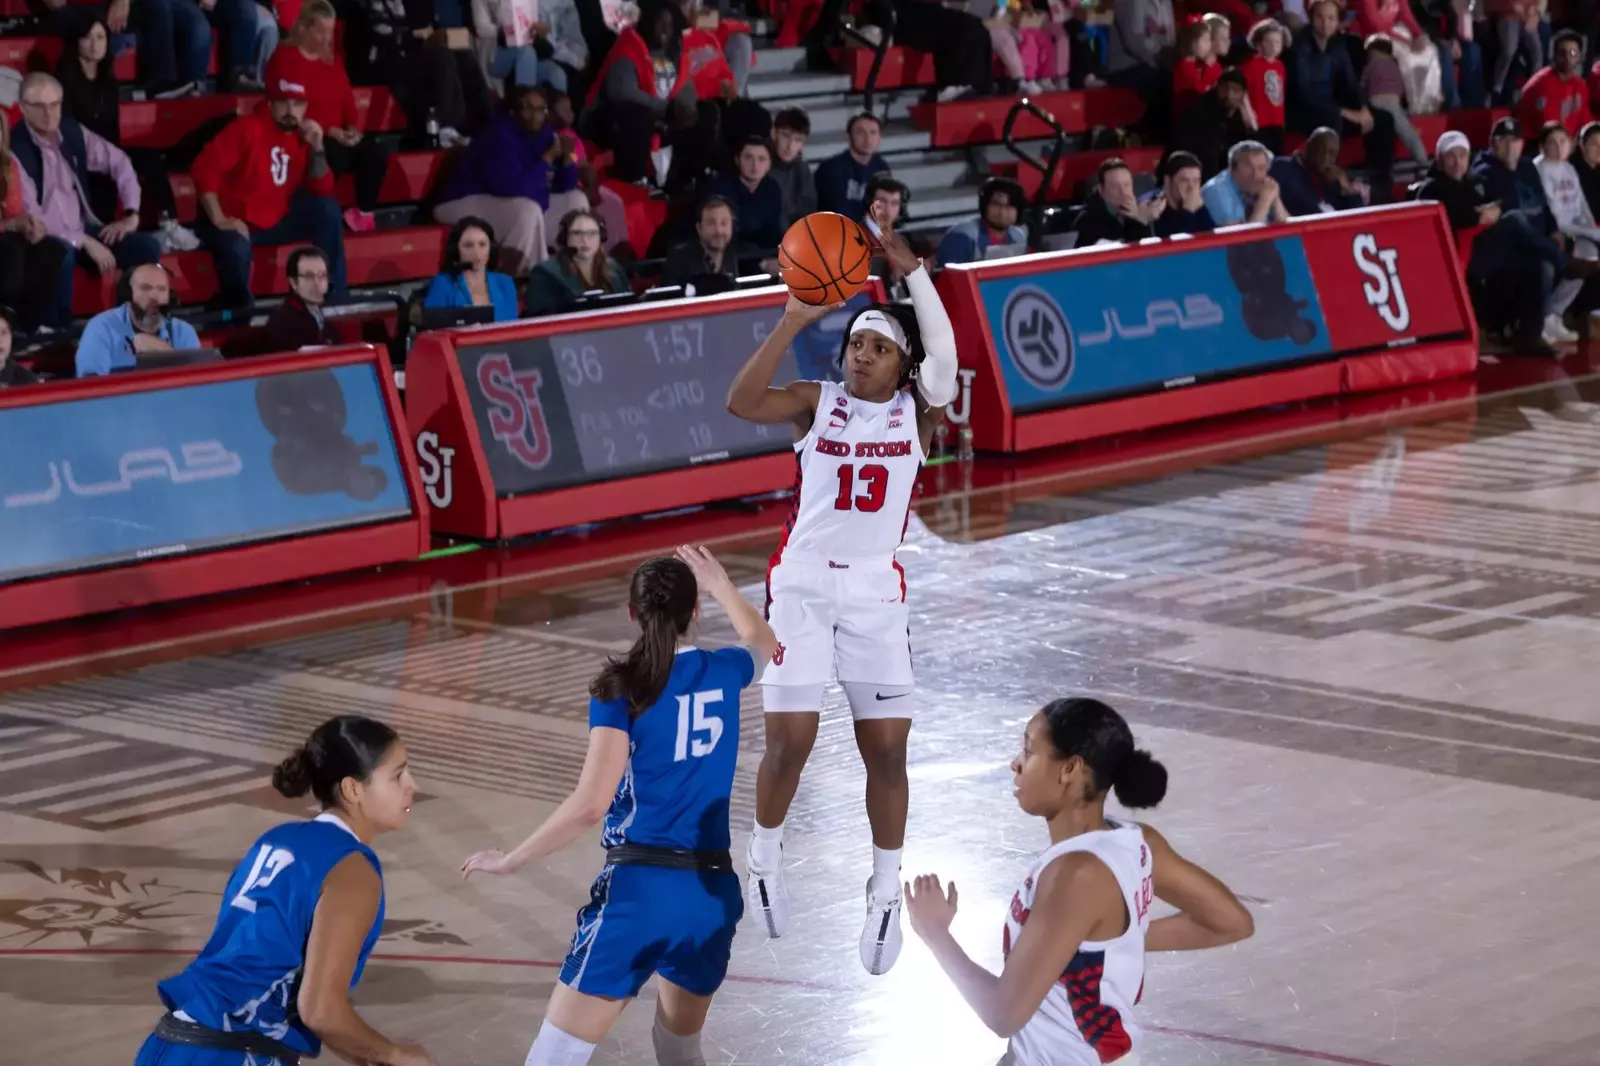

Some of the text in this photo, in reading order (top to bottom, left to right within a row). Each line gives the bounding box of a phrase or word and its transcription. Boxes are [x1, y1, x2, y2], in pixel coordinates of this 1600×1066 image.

[561, 344, 603, 386] 36
[644, 321, 704, 365] 1:57
[815, 436, 912, 457] RED STORM
[834, 463, 889, 513] 13
[673, 688, 724, 762] 15
